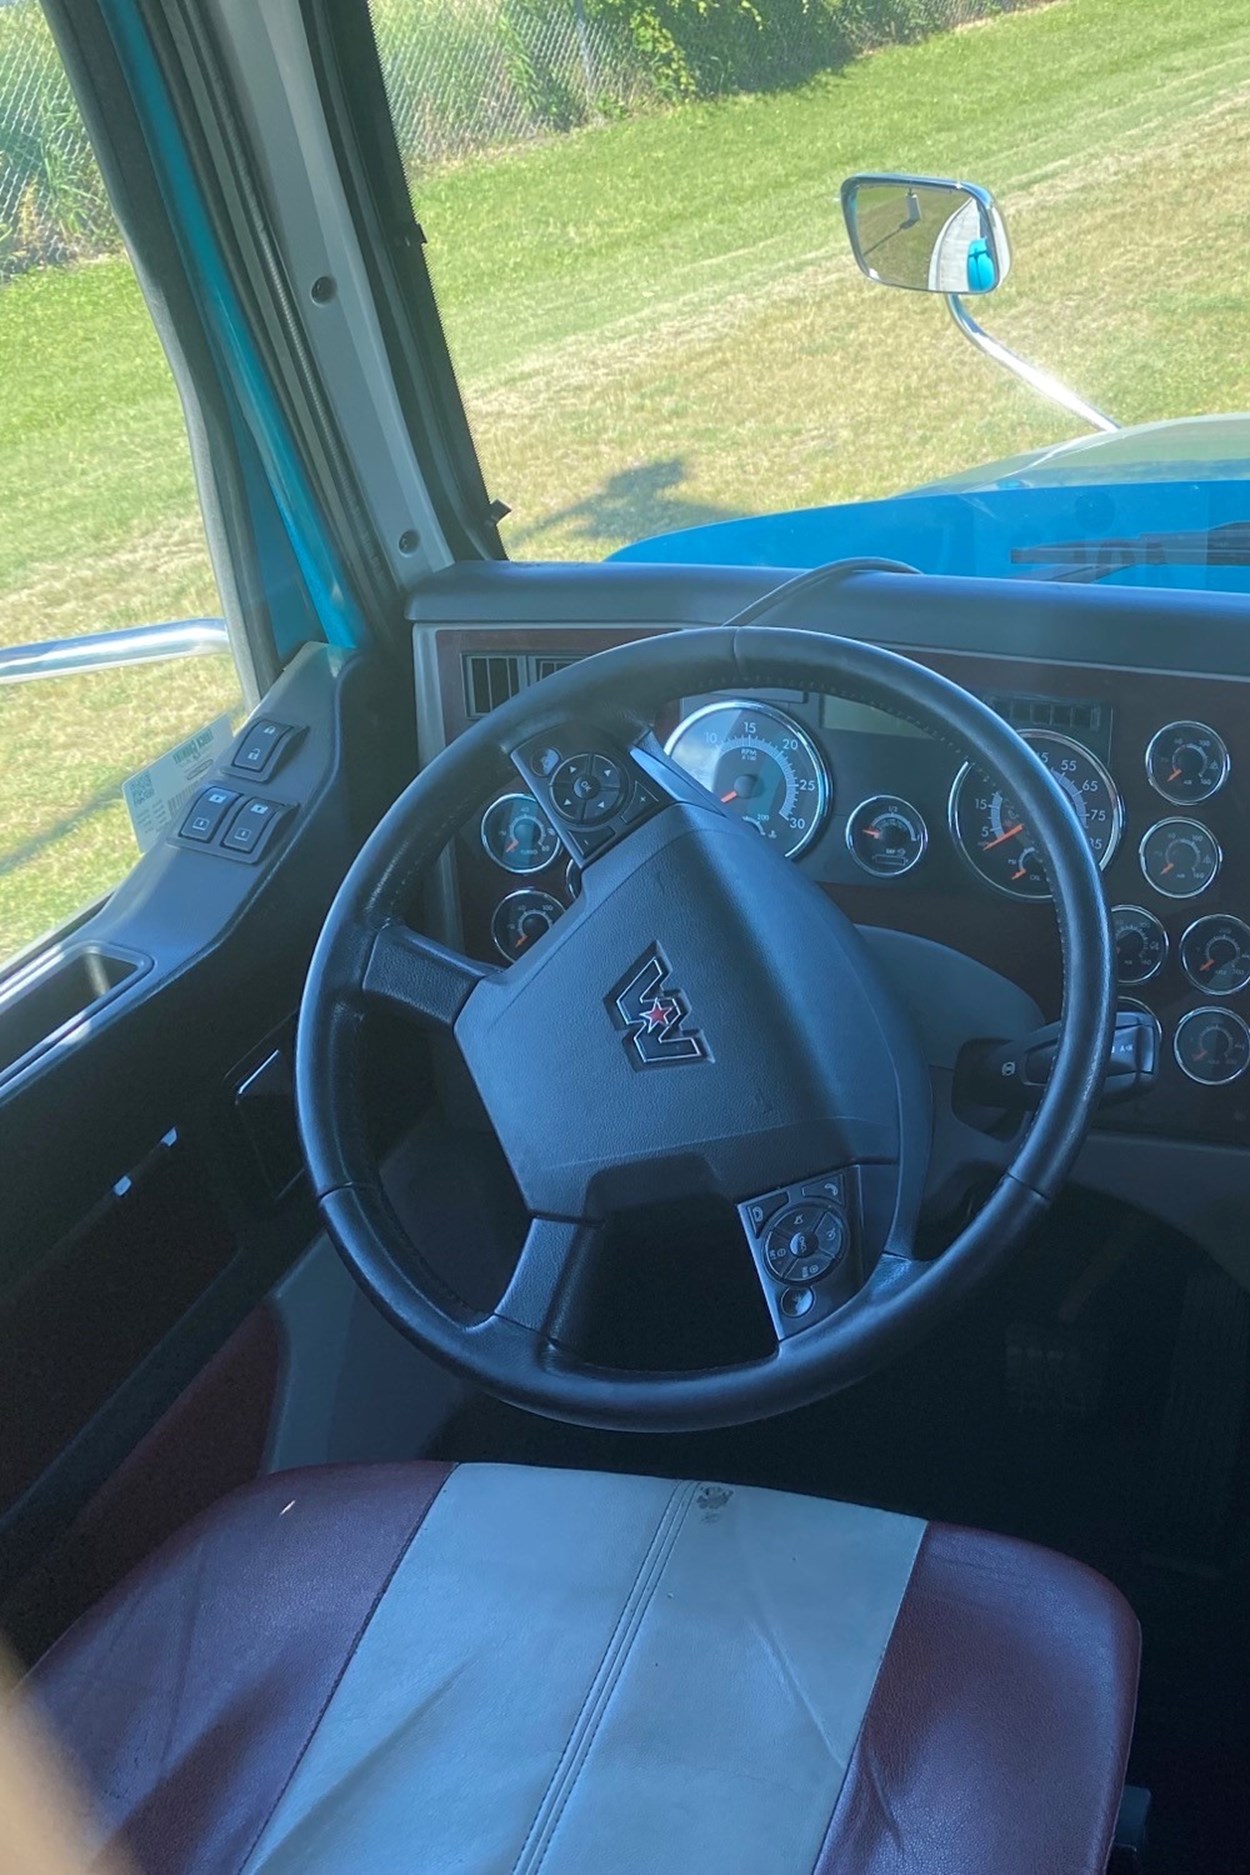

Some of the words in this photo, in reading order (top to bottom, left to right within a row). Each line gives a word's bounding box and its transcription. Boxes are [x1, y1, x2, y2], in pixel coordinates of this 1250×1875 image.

[744, 721, 756, 734] 15
[705, 732, 718, 744] 10
[782, 738, 799, 751] 20
[1036, 751, 1049, 764] 5
[1060, 759, 1077, 772] 55
[800, 779, 816, 792] 25
[1082, 779, 1099, 793] 65
[975, 798, 988, 810] 15
[1090, 810, 1106, 823] 75
[789, 817, 806, 830] 30
[981, 826, 990, 838] 5
